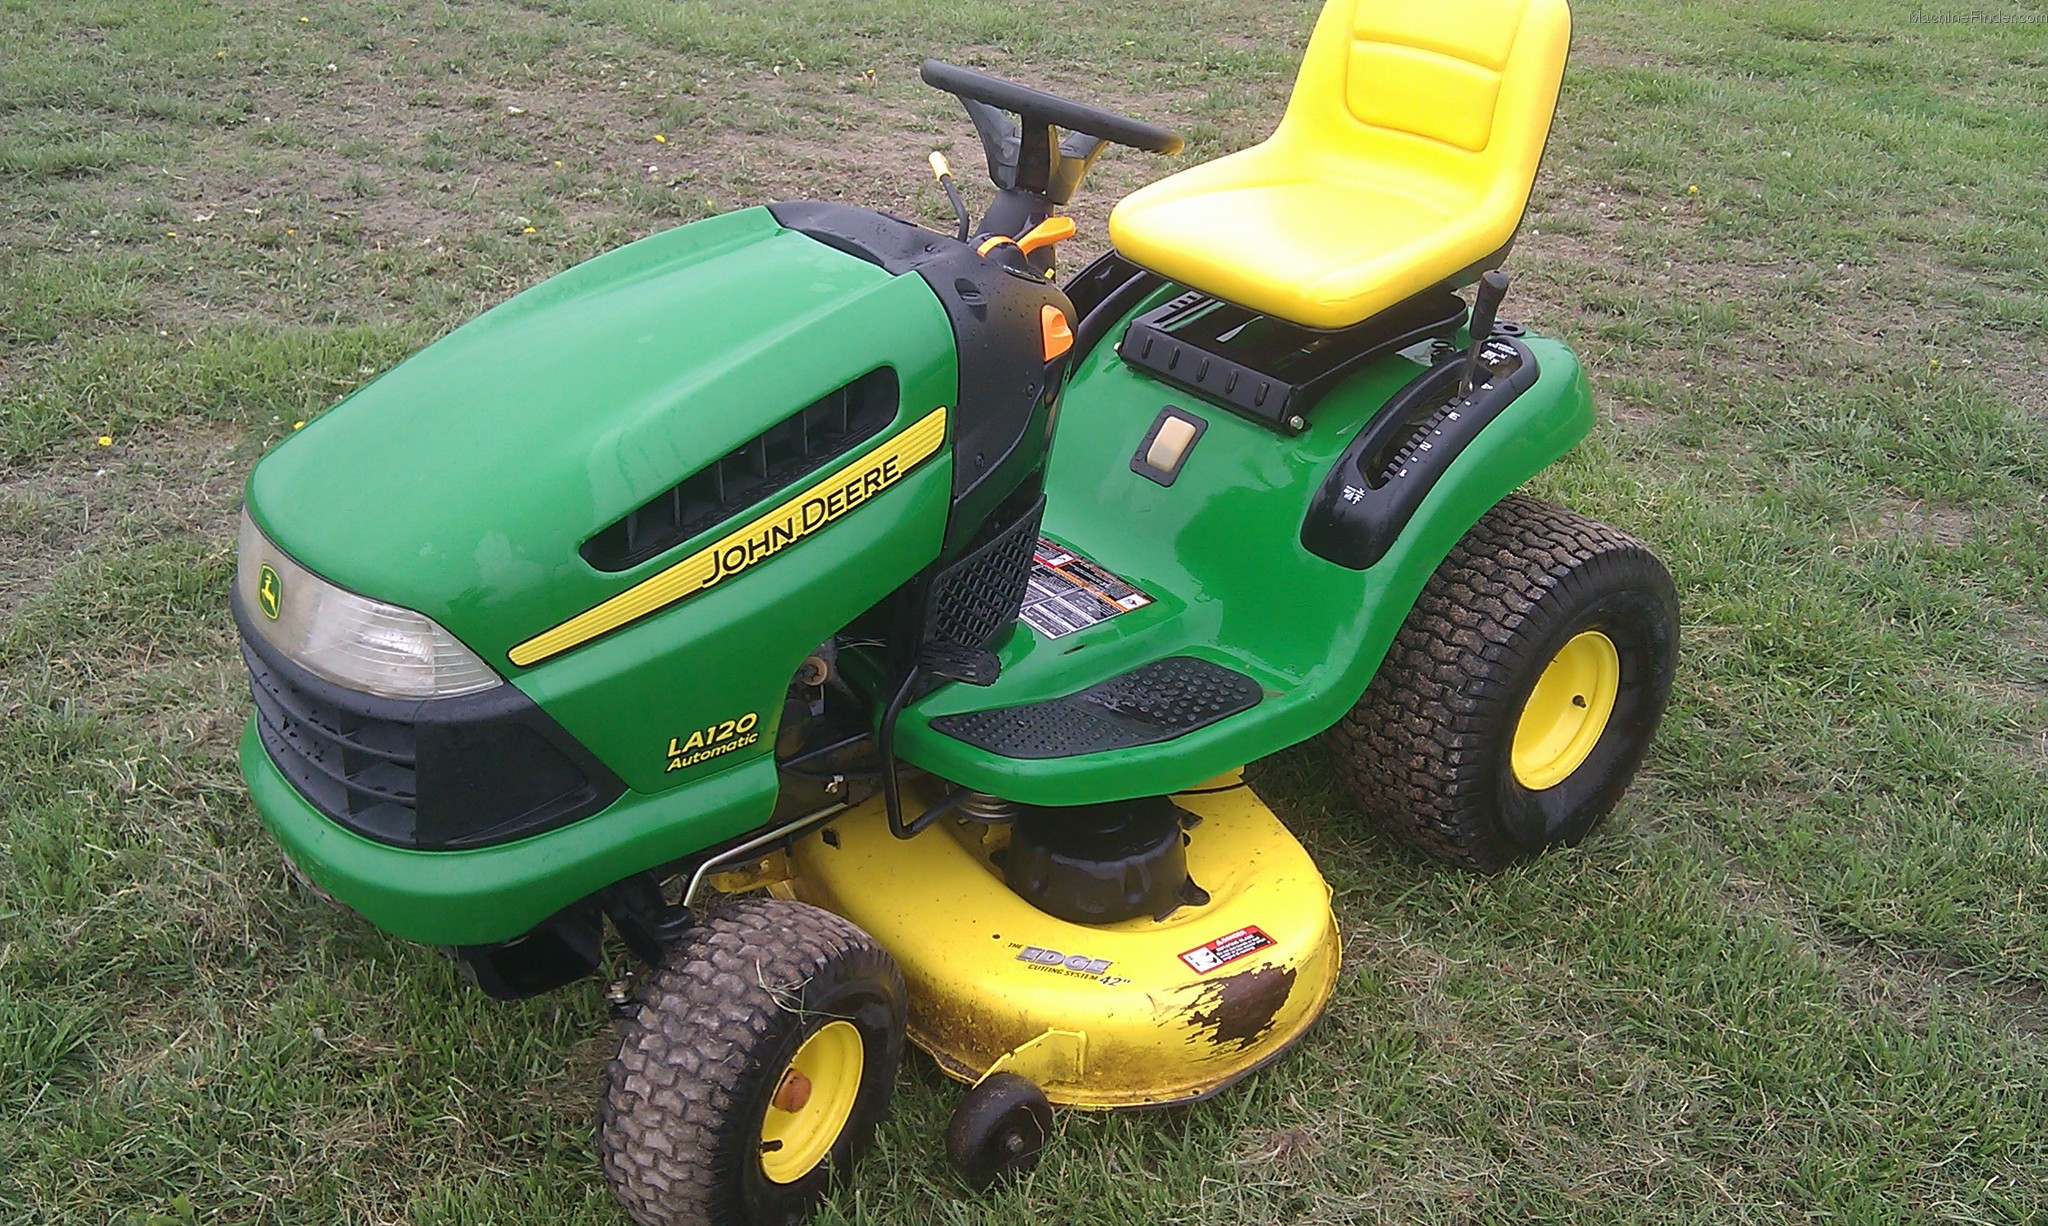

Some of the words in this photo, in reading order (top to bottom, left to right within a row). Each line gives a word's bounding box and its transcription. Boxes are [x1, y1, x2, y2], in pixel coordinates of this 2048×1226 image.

[702, 517, 793, 585] JOHN
[801, 454, 899, 531] DEERE
[666, 733, 758, 772] Automatic
[667, 712, 758, 757] LA120
[1015, 945, 1114, 976] EDGE
[1028, 963, 1063, 976] CUTTING
[1064, 970, 1099, 982] SYSTEM
[1099, 976, 1132, 987] 42"
